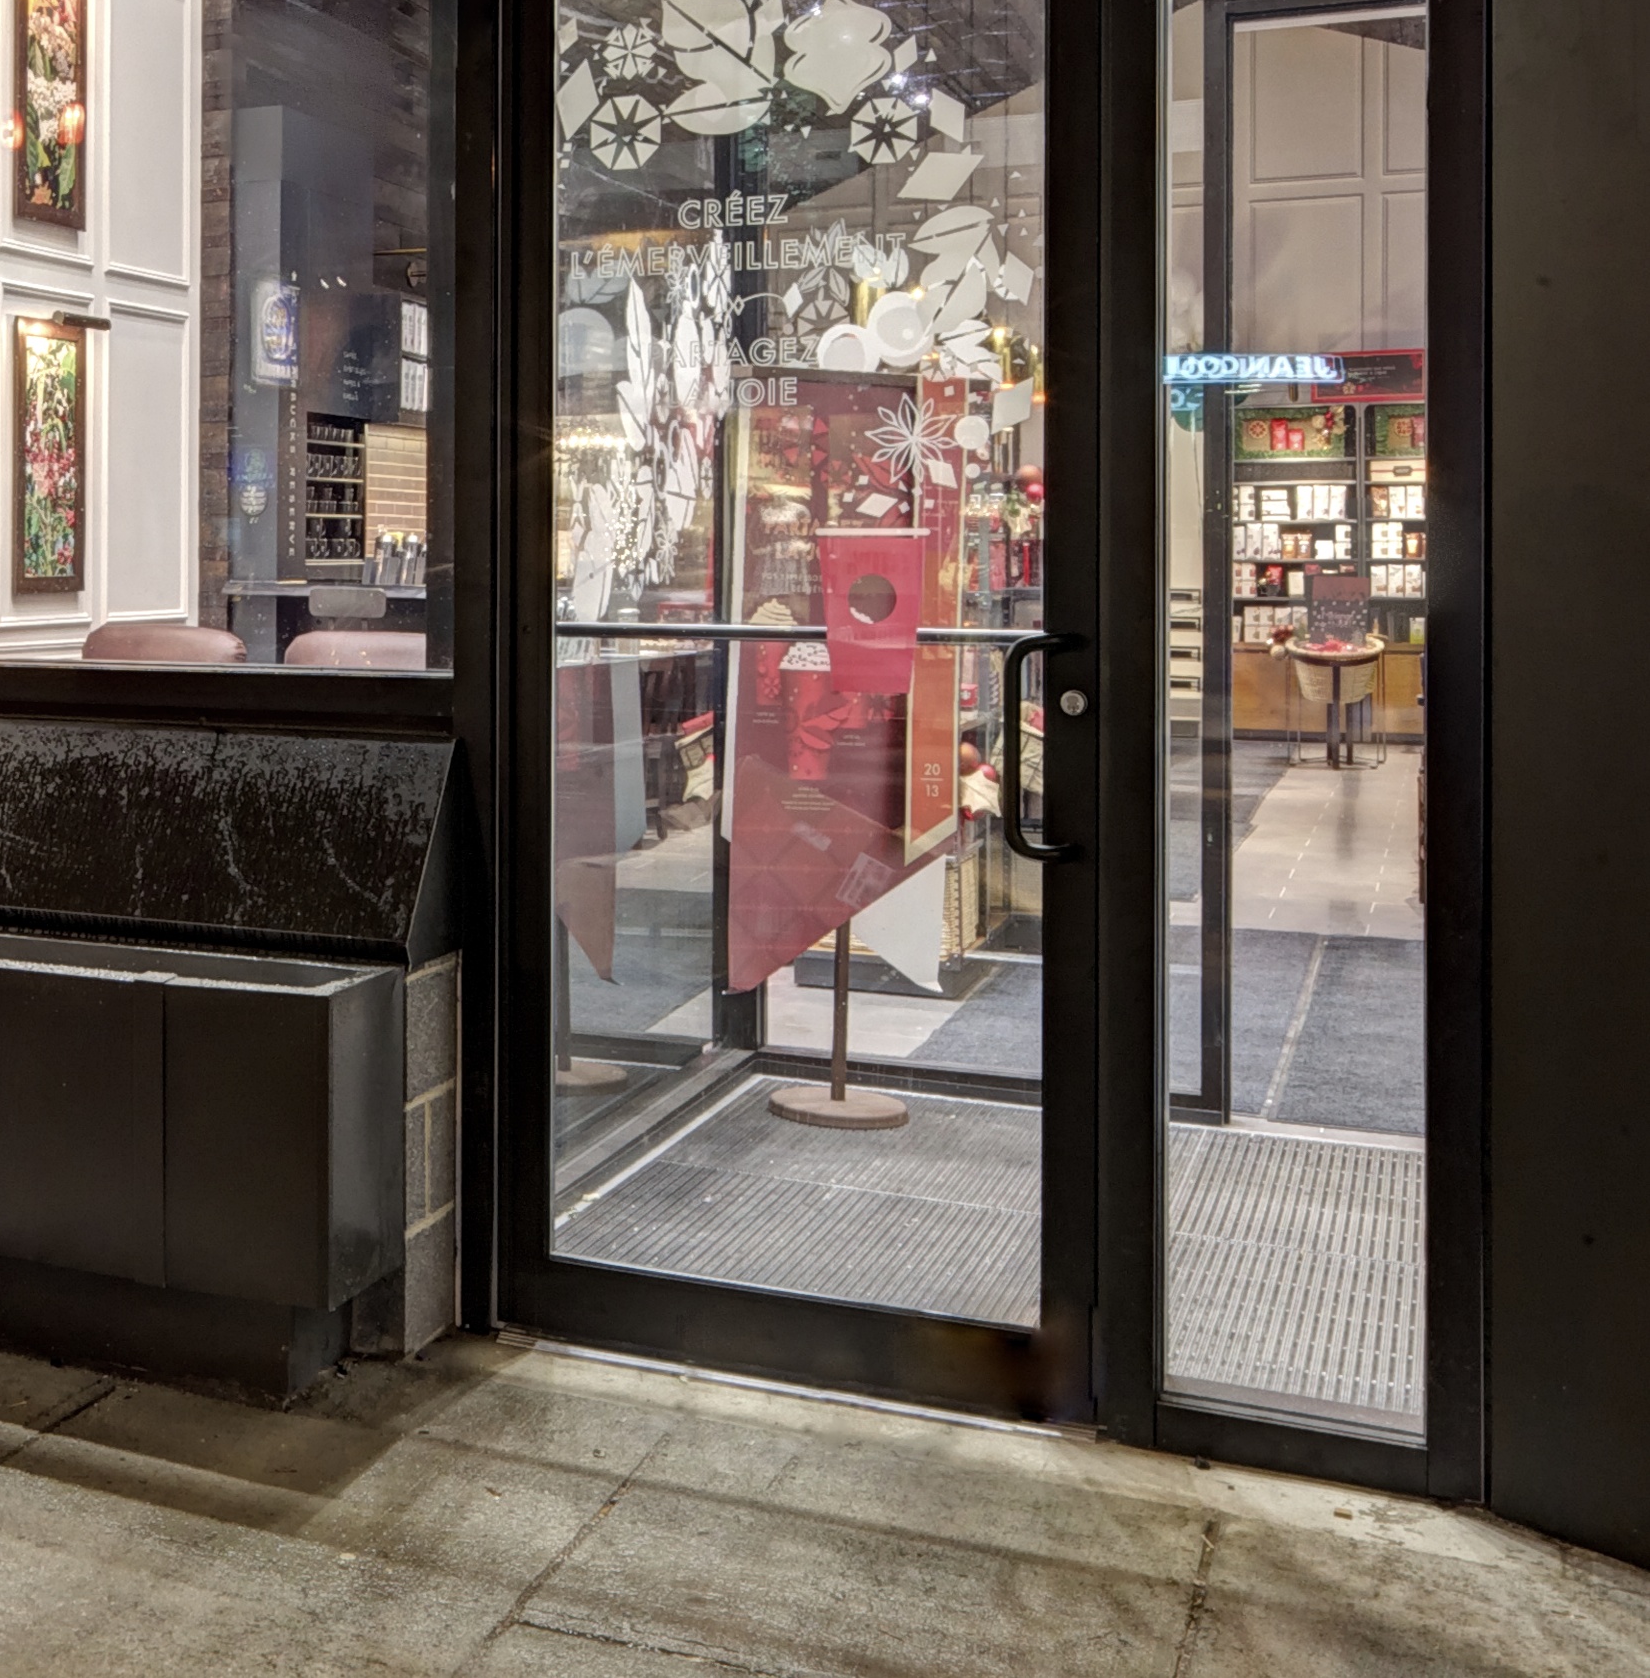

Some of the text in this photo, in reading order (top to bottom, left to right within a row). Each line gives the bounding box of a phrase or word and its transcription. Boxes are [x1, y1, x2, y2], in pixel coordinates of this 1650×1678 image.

[678, 190, 788, 229] CRÉEZ
[923, 763, 941, 775] 20
[925, 784, 939, 797] 13
